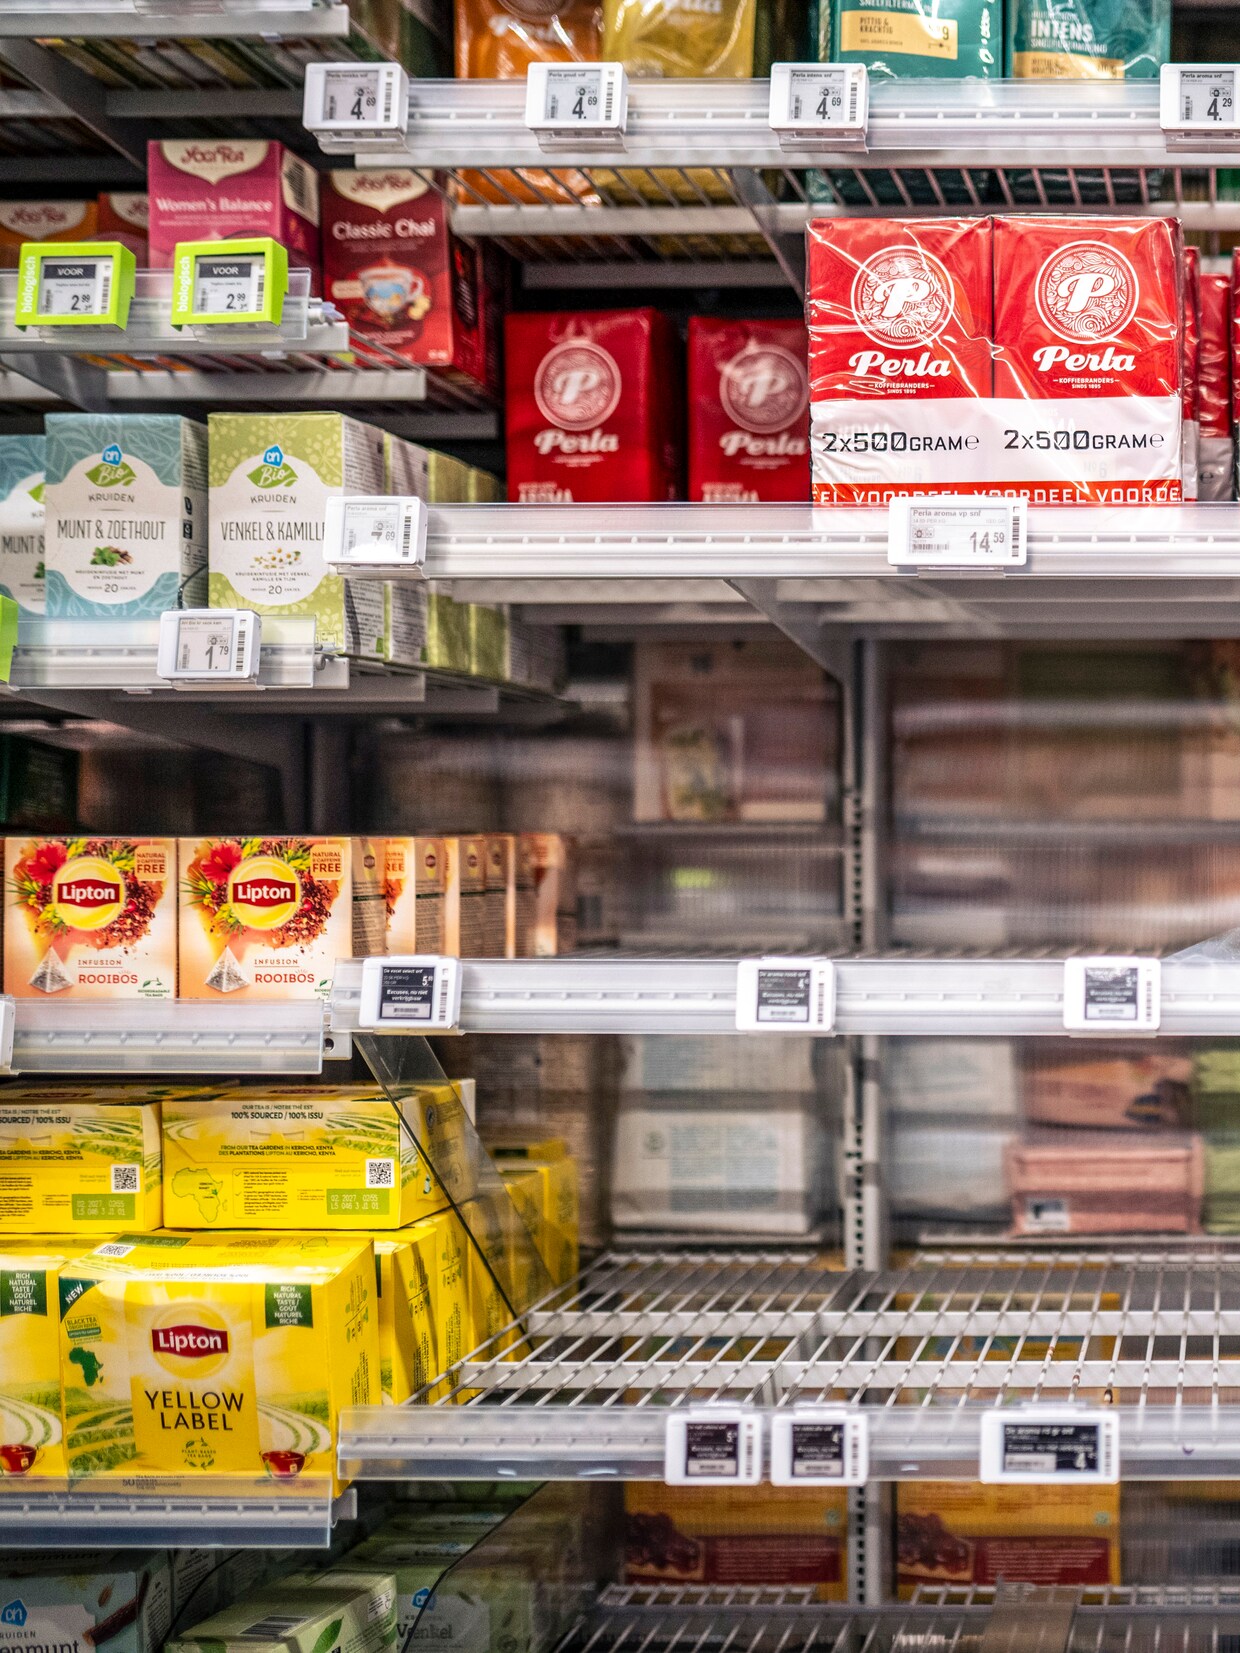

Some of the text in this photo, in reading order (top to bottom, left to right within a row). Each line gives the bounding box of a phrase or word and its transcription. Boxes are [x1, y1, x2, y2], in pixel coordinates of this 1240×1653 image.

[1030, 19, 1093, 42] INTENS
[156, 197, 274, 212] Women's Balance
[332, 218, 436, 240] Classic Chai
[57, 267, 84, 276] VOOR
[212, 266, 239, 275] VOOR
[21, 256, 36, 313] biologisch
[178, 256, 191, 312] biologisch
[848, 350, 951, 377] Perla
[1032, 345, 1137, 372] Perla
[533, 428, 619, 455] Perla
[719, 430, 807, 456] Perla
[99, 465, 125, 483] Bio
[260, 465, 286, 484] Bio
[88, 493, 134, 503] KRUIDEN
[250, 495, 297, 504] KRUIDEN
[912, 509, 929, 517] Perla
[57, 520, 166, 540] MUNT & ZOETHOUT
[221, 521, 265, 541] VENKEL
[266, 521, 275, 541] &
[2, 535, 35, 554] MUNT
[104, 584, 119, 593] 20
[268, 585, 283, 594] 20
[136, 864, 166, 873] FREE
[312, 863, 341, 873] FREE
[62, 884, 115, 903] Lipton
[237, 884, 291, 902] Lipton
[78, 973, 139, 984] ROOIBOS
[255, 973, 315, 983] ROOIBOS
[65, 1283, 84, 1304] NEW
[158, 1331, 222, 1352] Lipton
[144, 1390, 244, 1412] YELLOW
[160, 1412, 233, 1431] LABEL
